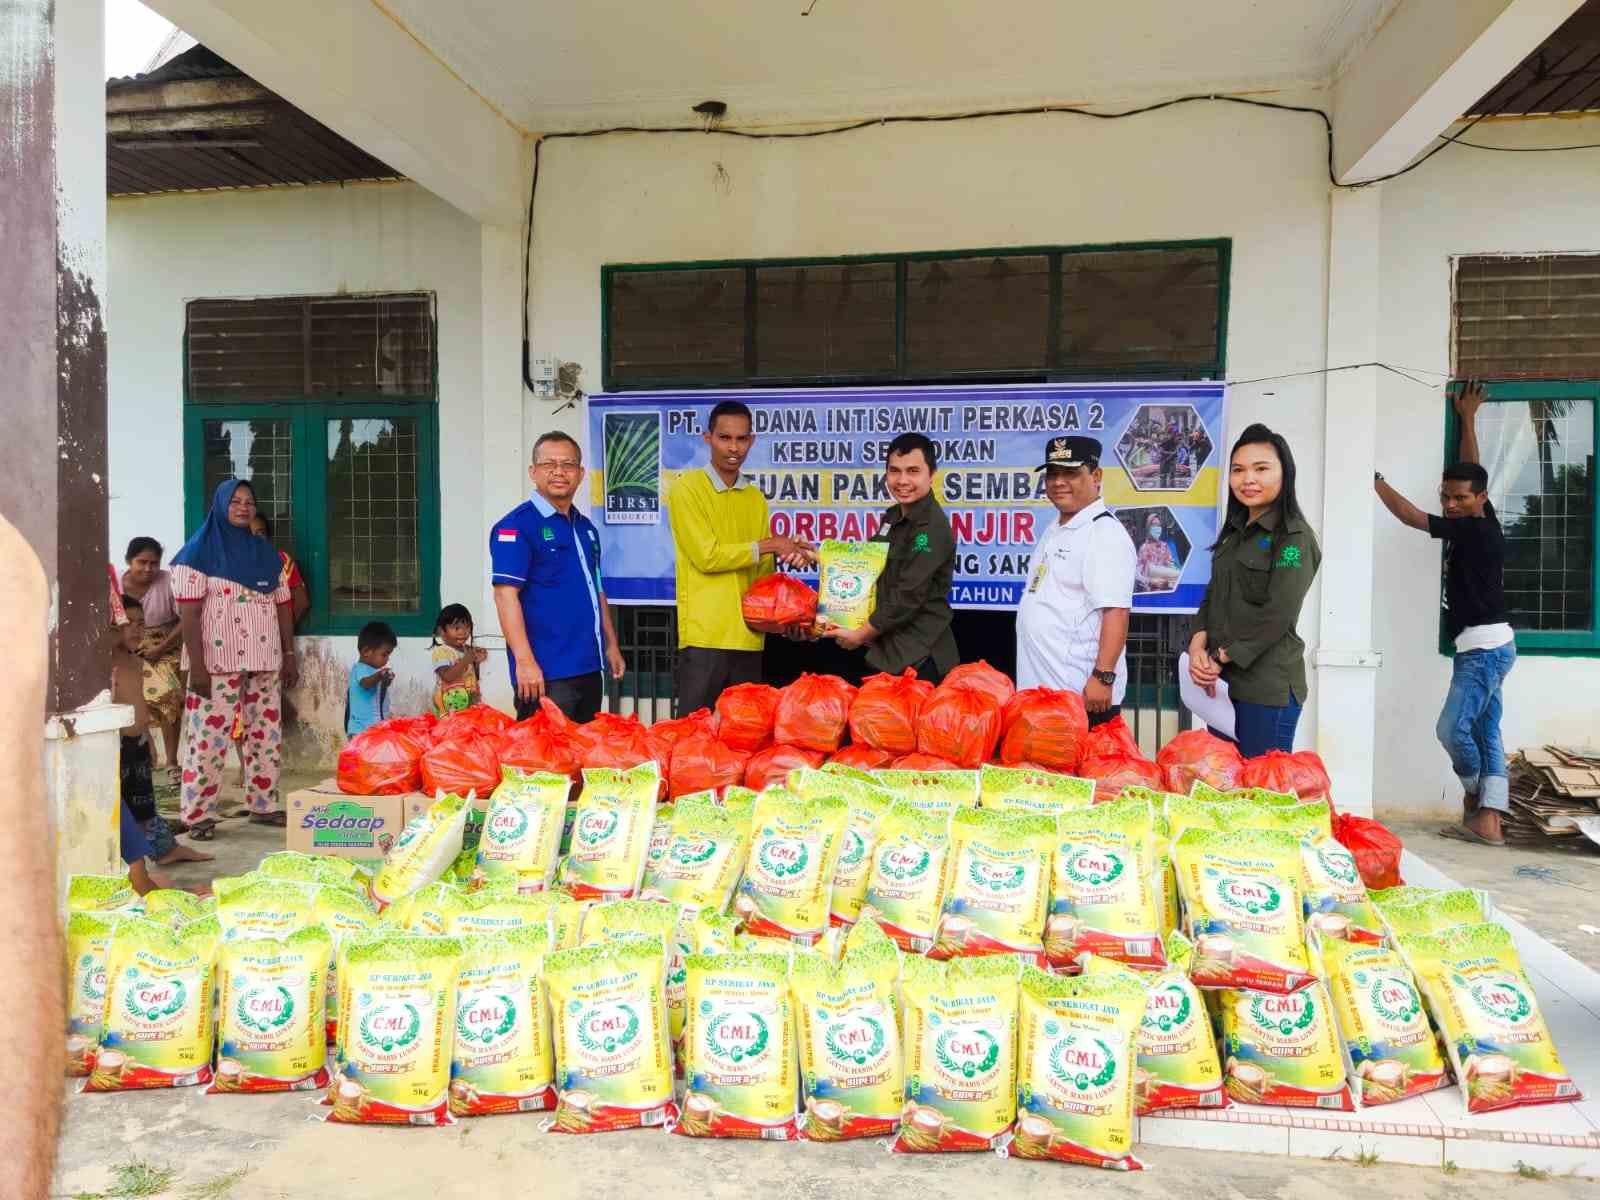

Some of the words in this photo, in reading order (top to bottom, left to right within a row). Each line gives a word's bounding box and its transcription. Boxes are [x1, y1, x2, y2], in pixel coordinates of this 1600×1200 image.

[668, 410, 702, 434] PT.
[753, 408, 818, 433] DANA
[826, 407, 953, 433] INTISAWIT
[963, 405, 1081, 431] PERKASA
[1088, 404, 1105, 430] 2
[773, 440, 853, 463] KEBUN
[862, 440, 996, 463] SEOKAN
[833, 473, 891, 501] PAK
[943, 472, 1047, 502] SEMBA
[608, 495, 657, 509] FIRST
[769, 511, 884, 542] ORBAN
[952, 510, 1036, 545] NJIR
[988, 553, 1031, 575] SAK
[951, 586, 1013, 602] TAHUN
[301, 814, 385, 832] Sedaap
[1078, 858, 1109, 872] CML
[1230, 885, 1268, 900] CML
[140, 989, 170, 1005] CML
[1382, 987, 1409, 1004] CML
[249, 997, 283, 1012] CML
[1264, 999, 1302, 1013] CML
[372, 1017, 407, 1031] CML
[468, 1007, 504, 1024] CML
[590, 1016, 627, 1033] CML
[719, 1024, 756, 1041] CML
[838, 1028, 872, 1046] CML
[950, 1040, 986, 1057] CML
[1065, 1048, 1103, 1069] CML
